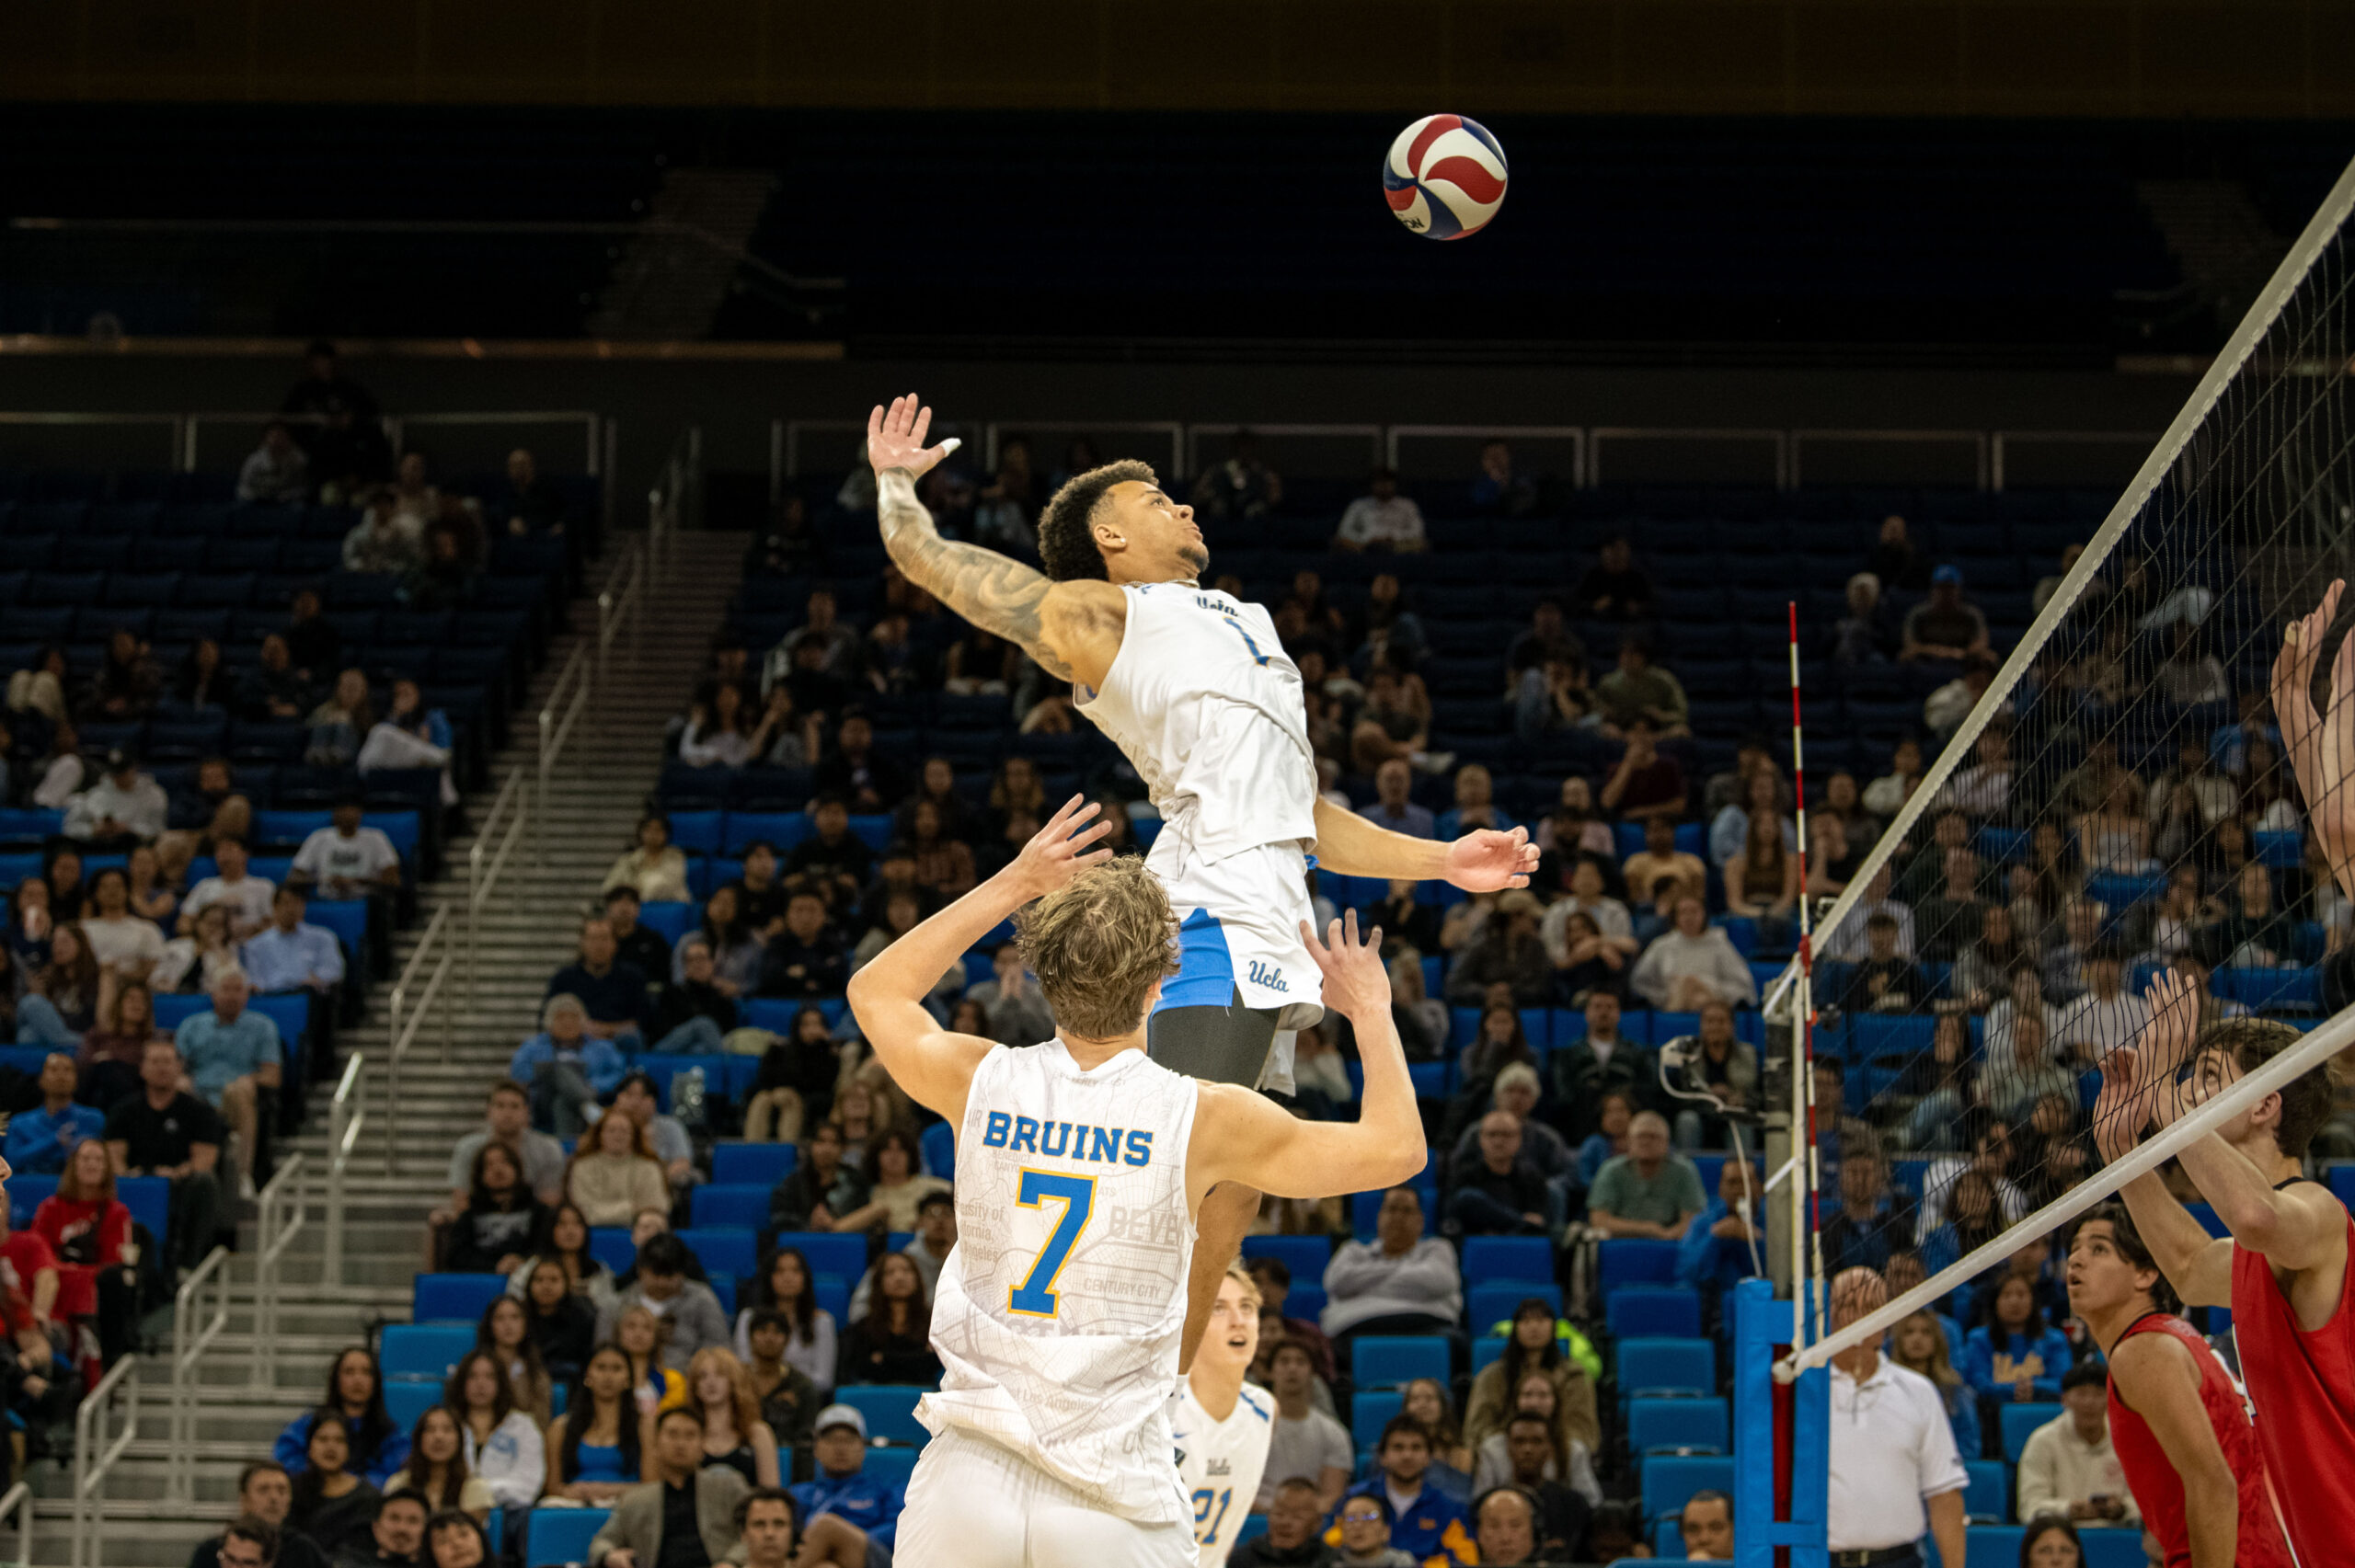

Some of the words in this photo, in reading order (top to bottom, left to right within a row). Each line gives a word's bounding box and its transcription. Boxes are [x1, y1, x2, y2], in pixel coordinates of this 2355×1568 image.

[1248, 959, 1290, 992] Ucla
[982, 1110, 1154, 1168] BRUINS
[1097, 1186, 1117, 1197] ATS
[1007, 1166, 1098, 1320] 7
[1084, 1277, 1137, 1296] CENTURY
[1138, 1284, 1162, 1299] CITY
[1191, 1486, 1234, 1547] 21
